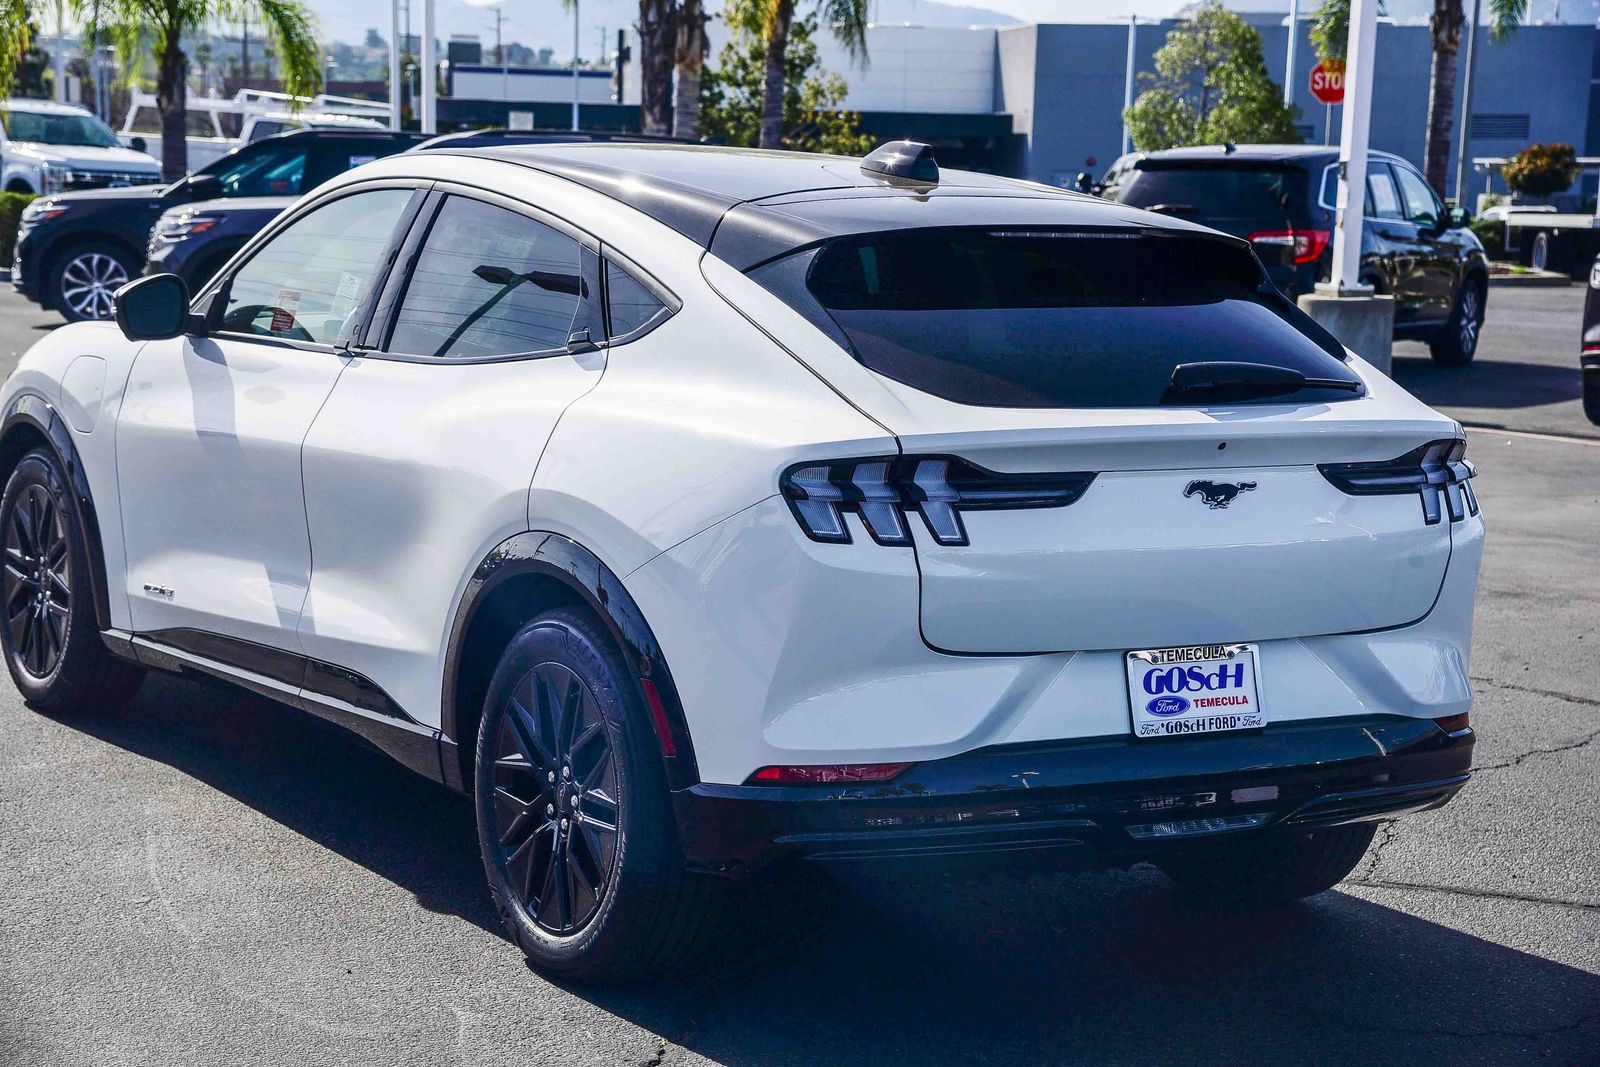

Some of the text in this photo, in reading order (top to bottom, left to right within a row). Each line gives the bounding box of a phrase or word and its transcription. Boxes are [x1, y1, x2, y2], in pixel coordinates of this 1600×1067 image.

[1313, 71, 1345, 90] STO
[1158, 646, 1227, 662] TEMECULA
[1155, 699, 1180, 713] Ford
[1193, 695, 1249, 708] TEMECULA
[1140, 723, 1160, 735] Ford
[1208, 715, 1237, 730] FORD
[1242, 715, 1262, 727] Ford
